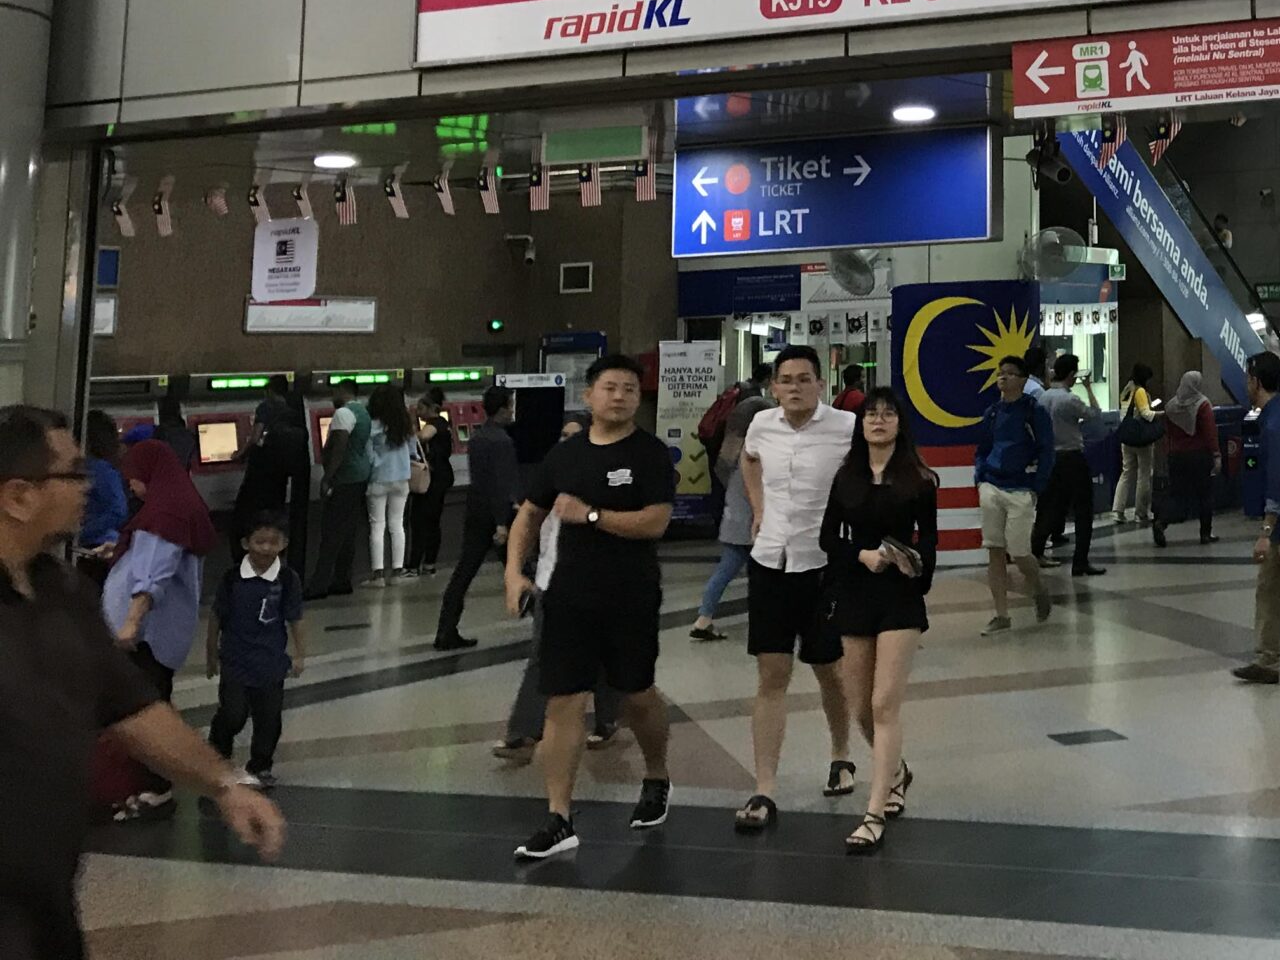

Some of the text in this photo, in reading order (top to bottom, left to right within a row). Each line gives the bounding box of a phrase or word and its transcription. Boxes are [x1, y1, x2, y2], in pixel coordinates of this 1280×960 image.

[1173, 34, 1200, 45] Untuk
[1202, 29, 1251, 44] perjalanan
[1253, 29, 1265, 37] ke
[1079, 45, 1104, 57] MR1
[1173, 44, 1188, 54] sila
[1191, 42, 1207, 53] beli
[1210, 40, 1235, 51] token
[1238, 39, 1247, 48] di
[1173, 48, 1265, 65] (melalui Nu Sentral)
[1175, 88, 1280, 103] LRT Laluan Kelana Jaya
[1077, 101, 1112, 112] rapidKL
[760, 155, 831, 182] Tiket
[760, 183, 803, 197] TICKET
[759, 208, 809, 236] LRT
[1108, 152, 1209, 311] ami bersama anda.
[1219, 317, 1248, 373] Allia
[661, 375, 677, 383] TnG
